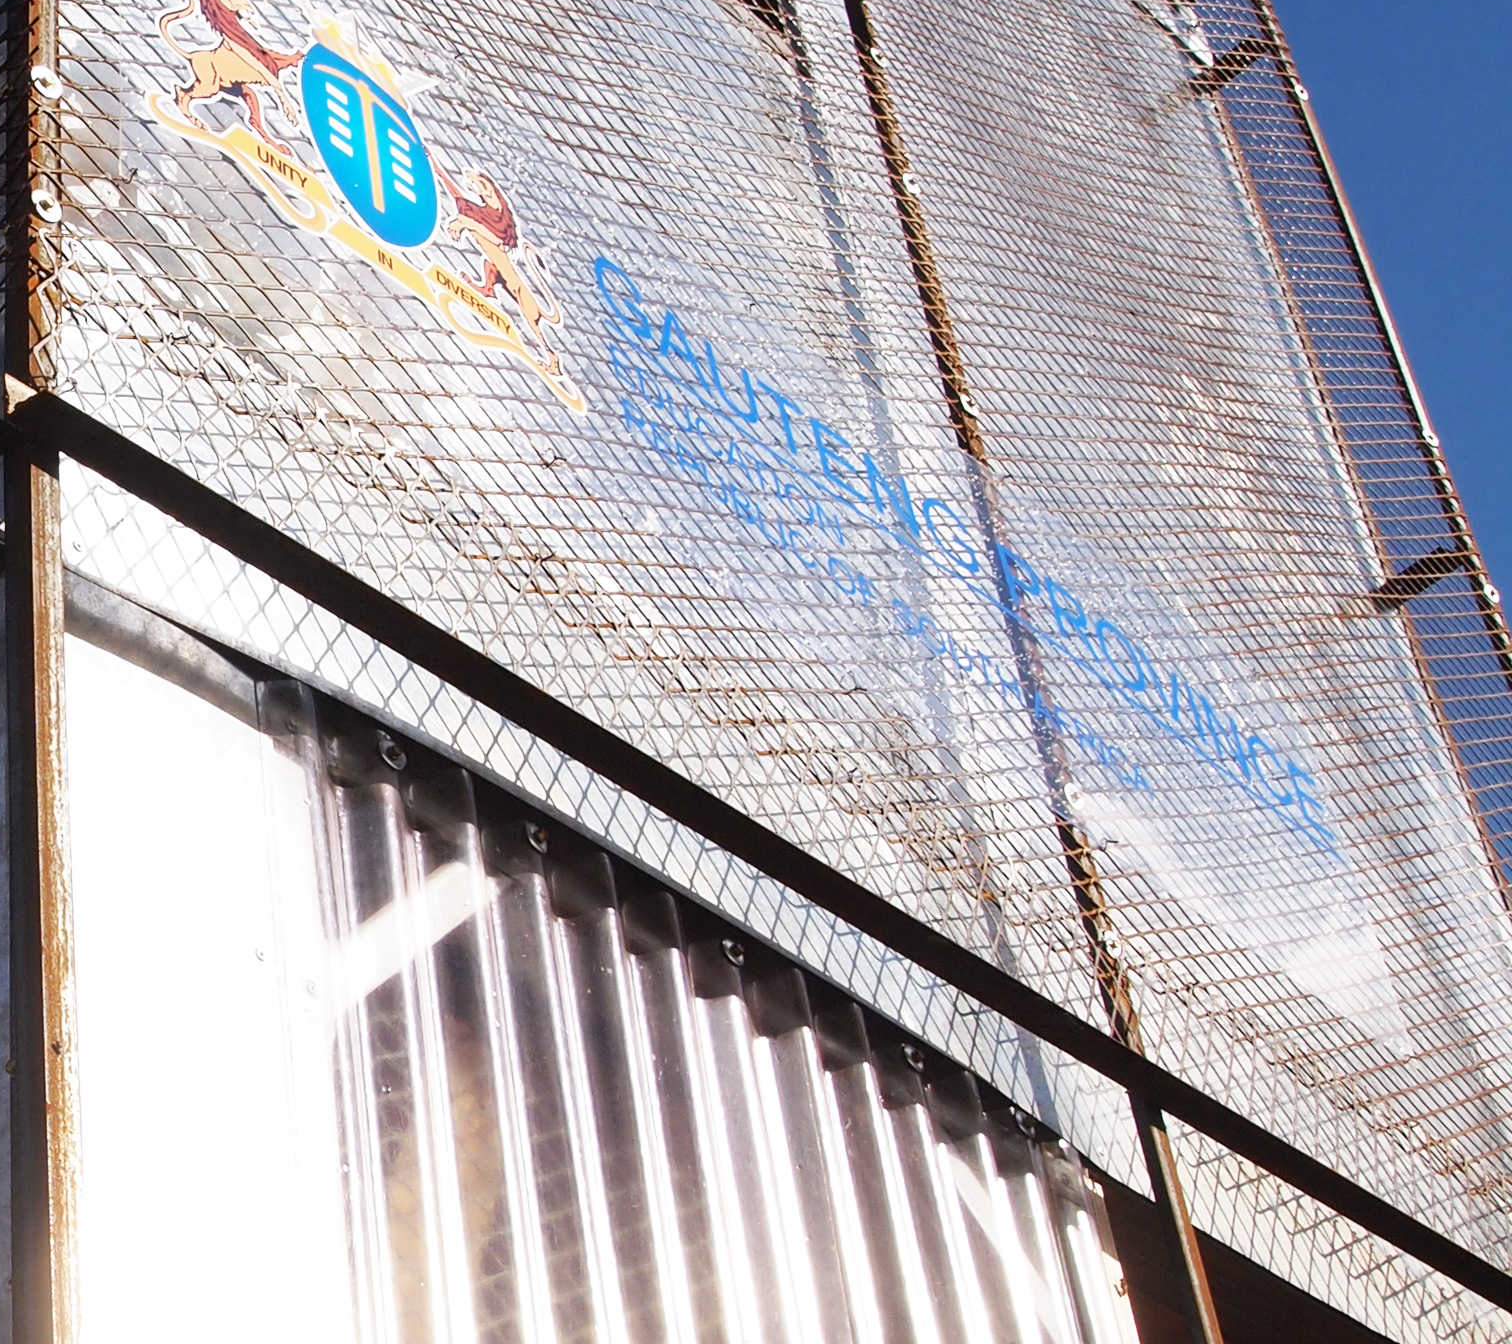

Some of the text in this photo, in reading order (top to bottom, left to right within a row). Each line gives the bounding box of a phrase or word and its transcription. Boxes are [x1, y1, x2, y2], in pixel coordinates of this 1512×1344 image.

[256, 144, 512, 335] UNITY IN DIVERSITY
[593, 256, 1336, 841] GAUTENG PROVINCE
[608, 341, 846, 547] EDUCATION
[621, 397, 1156, 801] REPUBLIC OF SOUTH AFRICA
